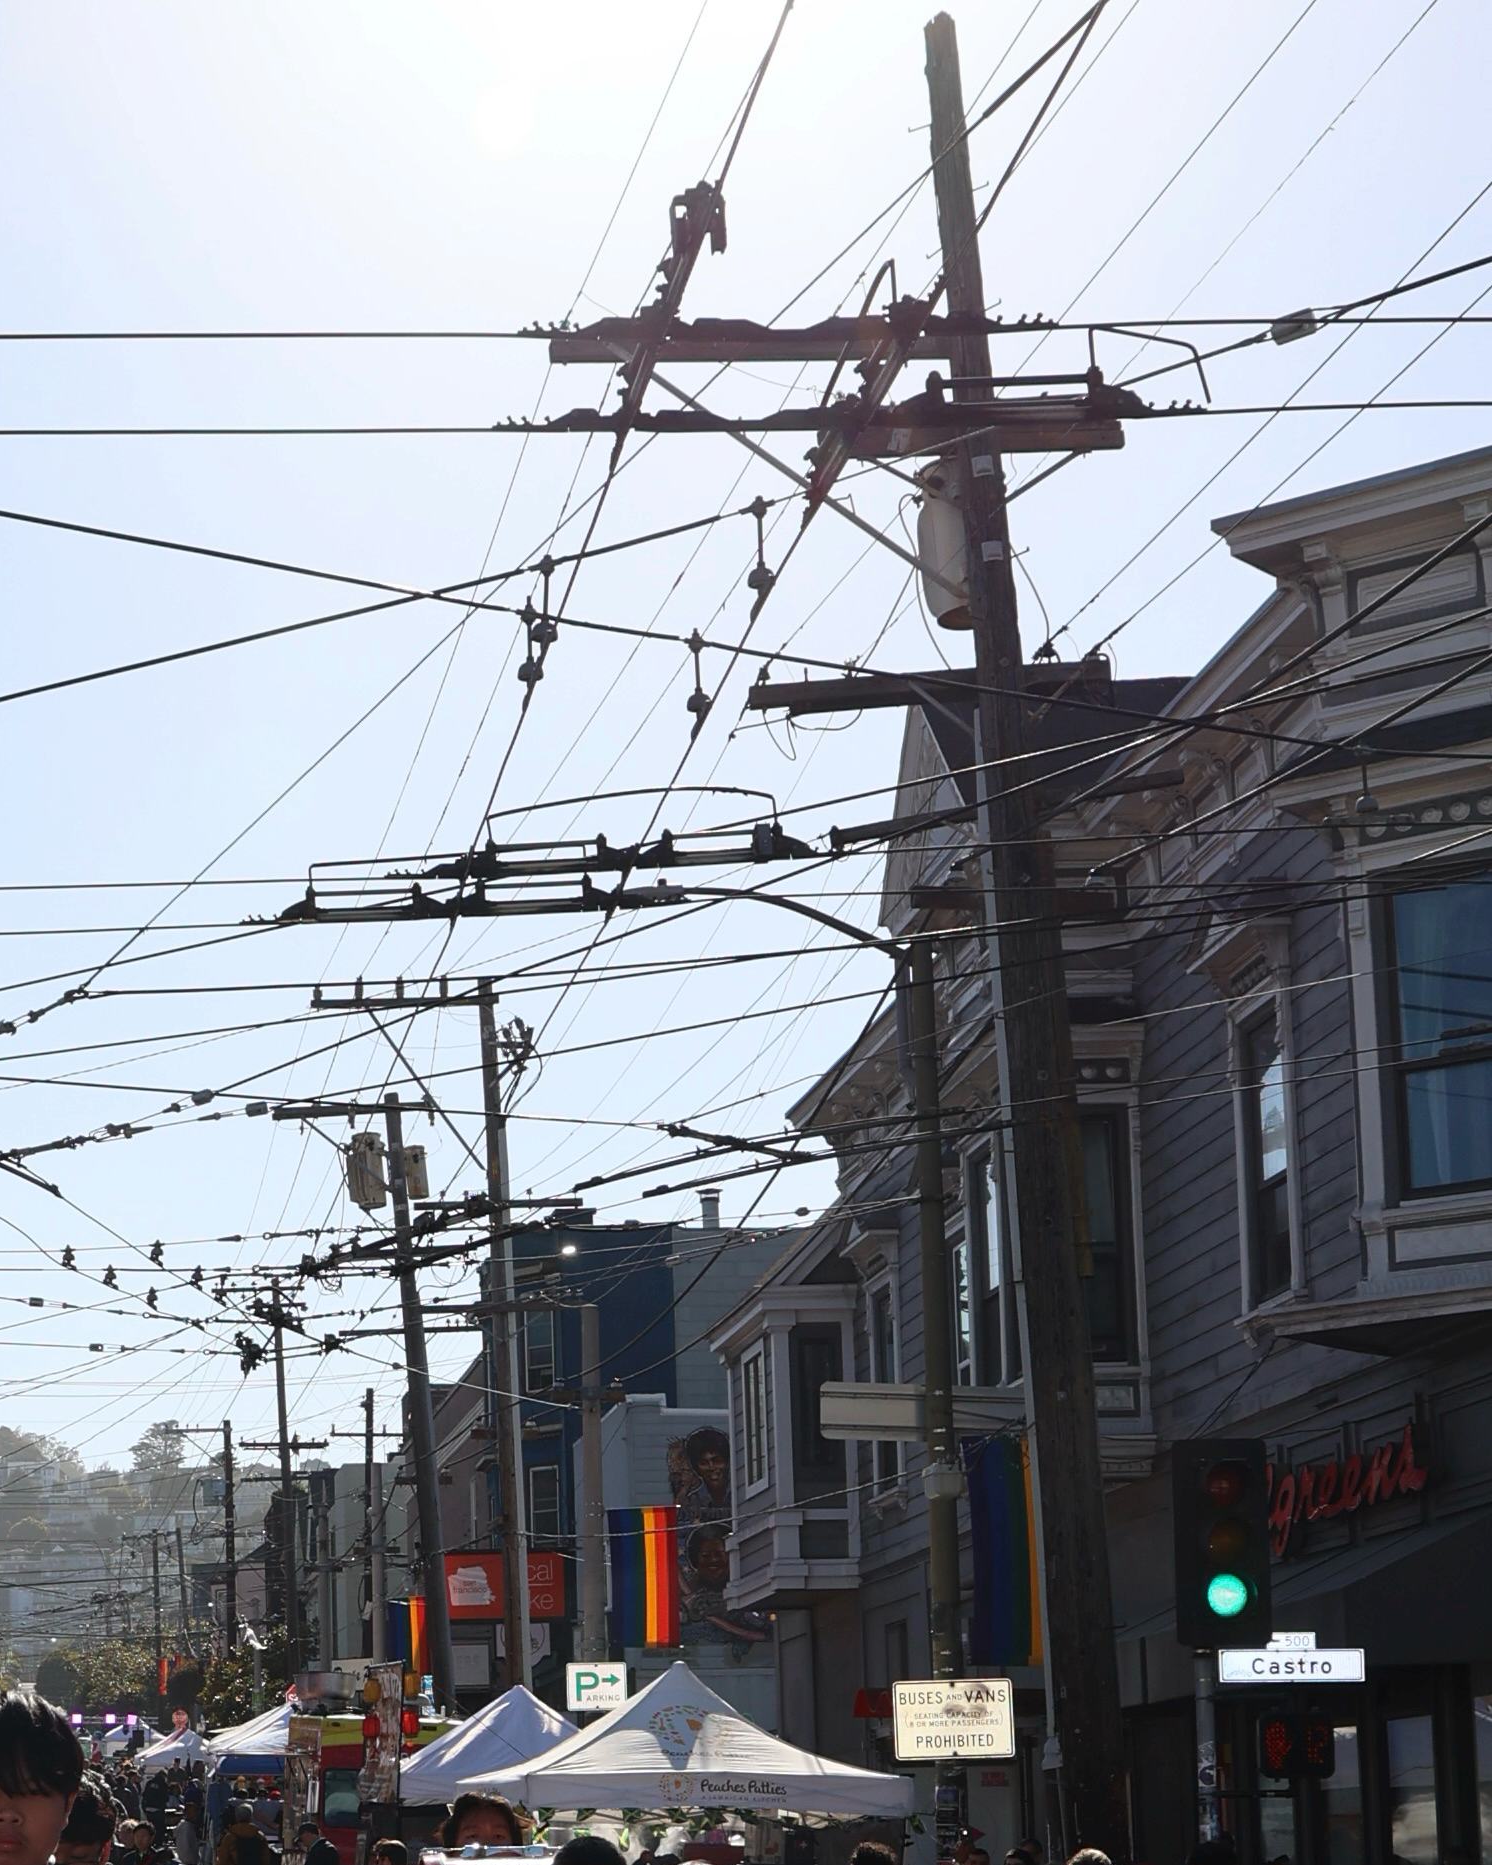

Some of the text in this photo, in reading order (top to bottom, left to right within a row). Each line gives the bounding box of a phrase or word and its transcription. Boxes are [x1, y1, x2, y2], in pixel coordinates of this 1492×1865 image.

[1285, 1635, 1310, 1647] 500
[1251, 1657, 1333, 1675] Castro
[899, 1689, 1006, 1706] BUSES AND VANS
[946, 1711, 982, 1719] CAPACITY
[929, 1720, 949, 1728] MORE
[951, 1719, 999, 1727] PASSENGERS
[916, 1733, 995, 1749] PROHIBITED
[700, 1779, 787, 1795] Peaches Patties
